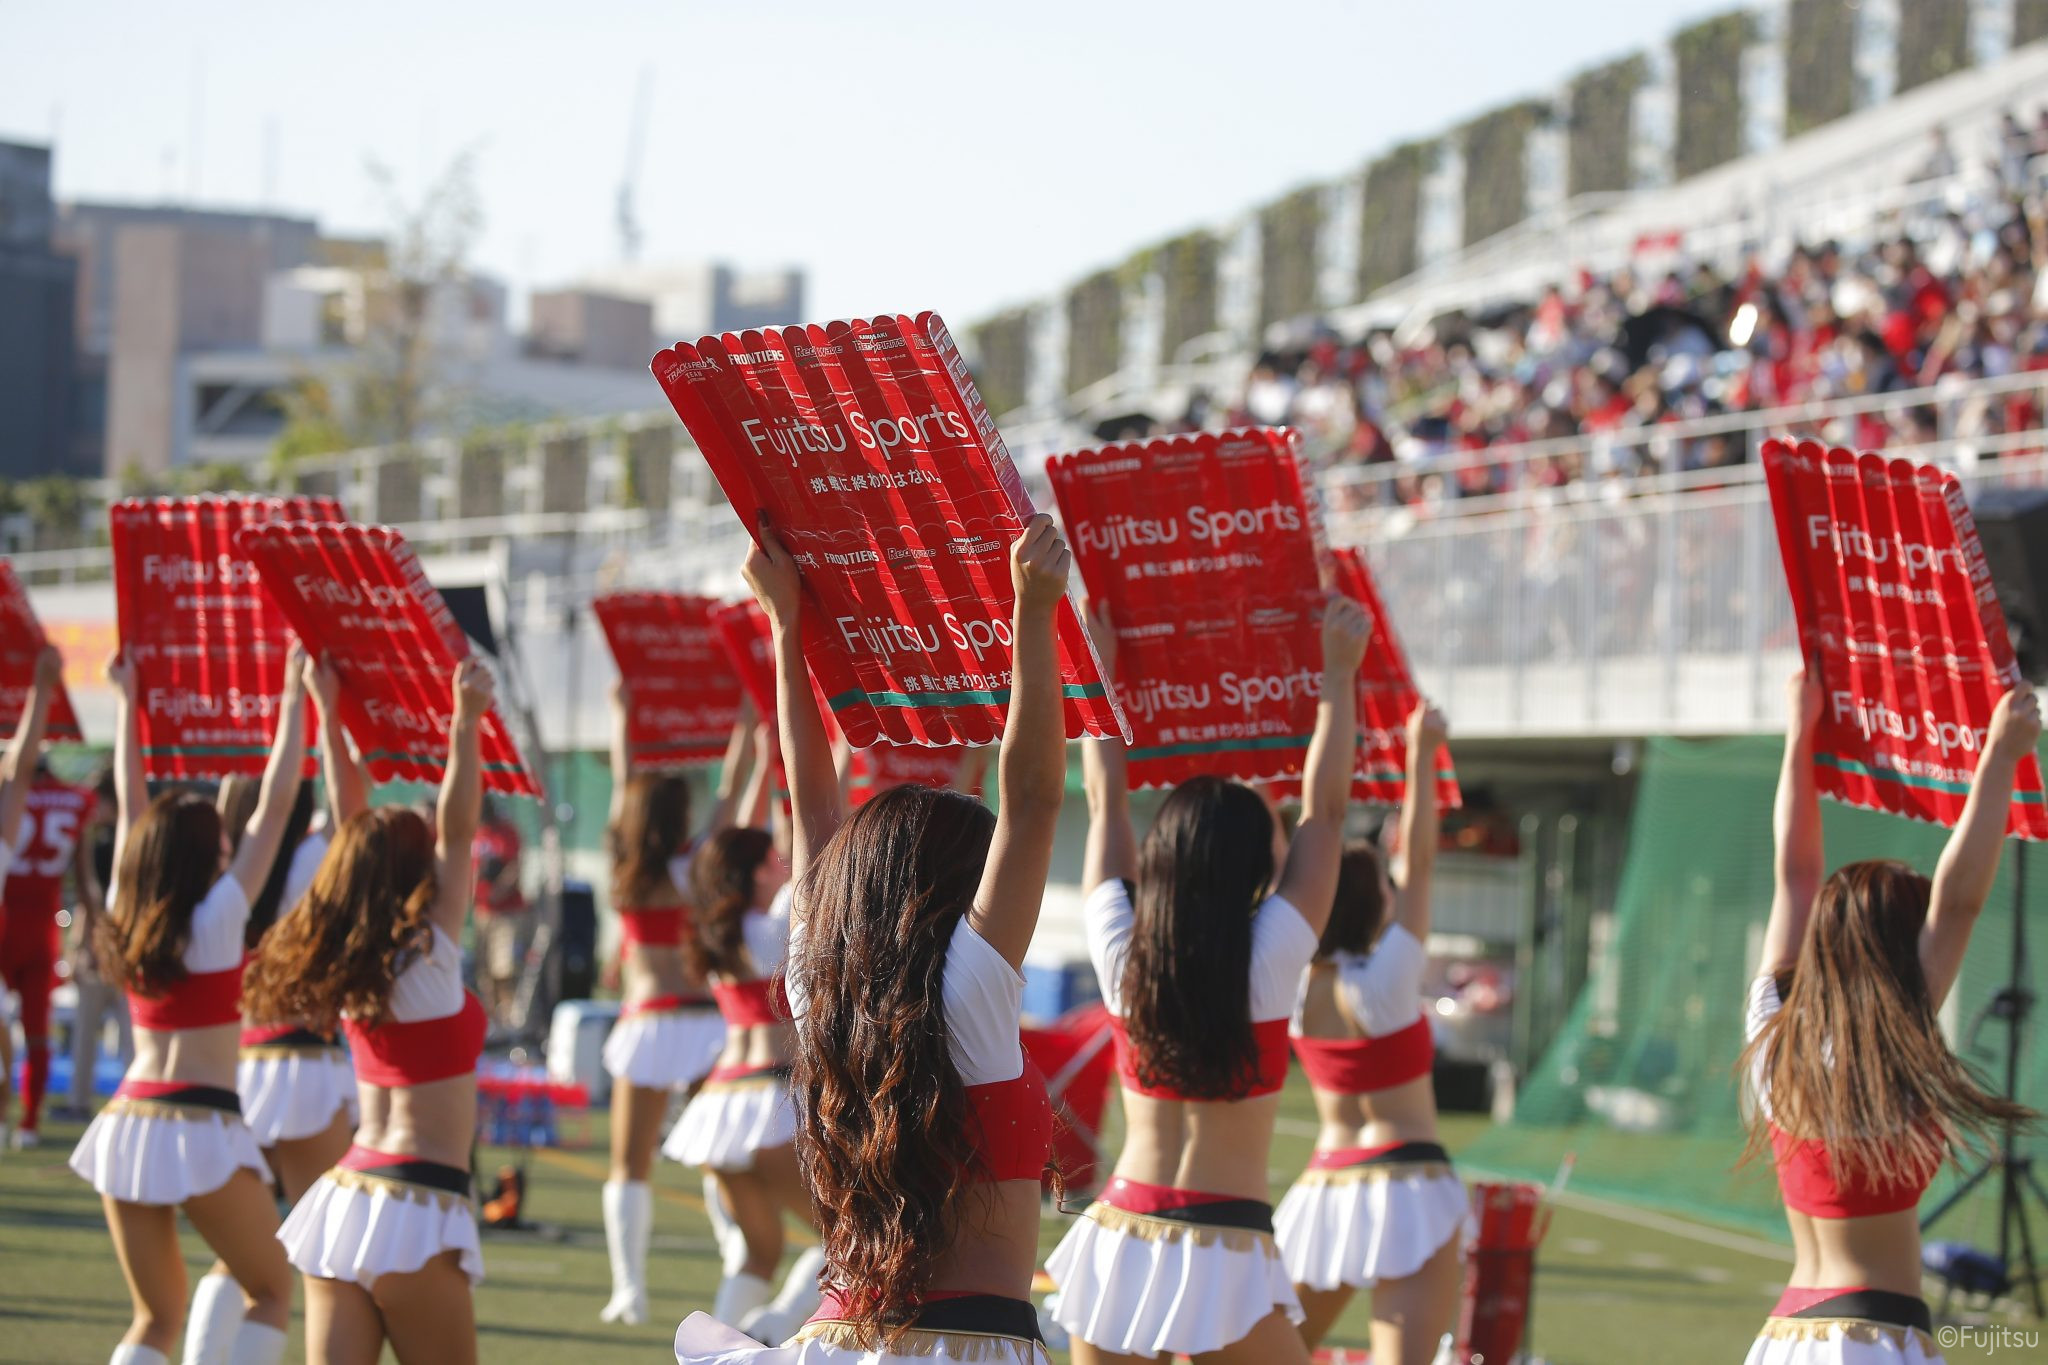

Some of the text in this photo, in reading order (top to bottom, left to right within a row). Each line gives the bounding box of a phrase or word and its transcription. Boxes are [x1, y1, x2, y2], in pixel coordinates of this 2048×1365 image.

[685, 371, 703, 379] TEAM
[728, 350, 785, 365] FRONTIERS
[742, 403, 969, 467] Fujitsu Sports
[1076, 501, 1300, 560] Fujitsu Sports
[218, 553, 261, 592] Spo
[824, 550, 880, 566] FRONTIERS
[836, 612, 1014, 666] Fujitsu Spo
[904, 671, 1012, 692] 挑戦に終わりはな
[228, 686, 283, 725] Spor
[1923, 709, 1989, 758] Spor
